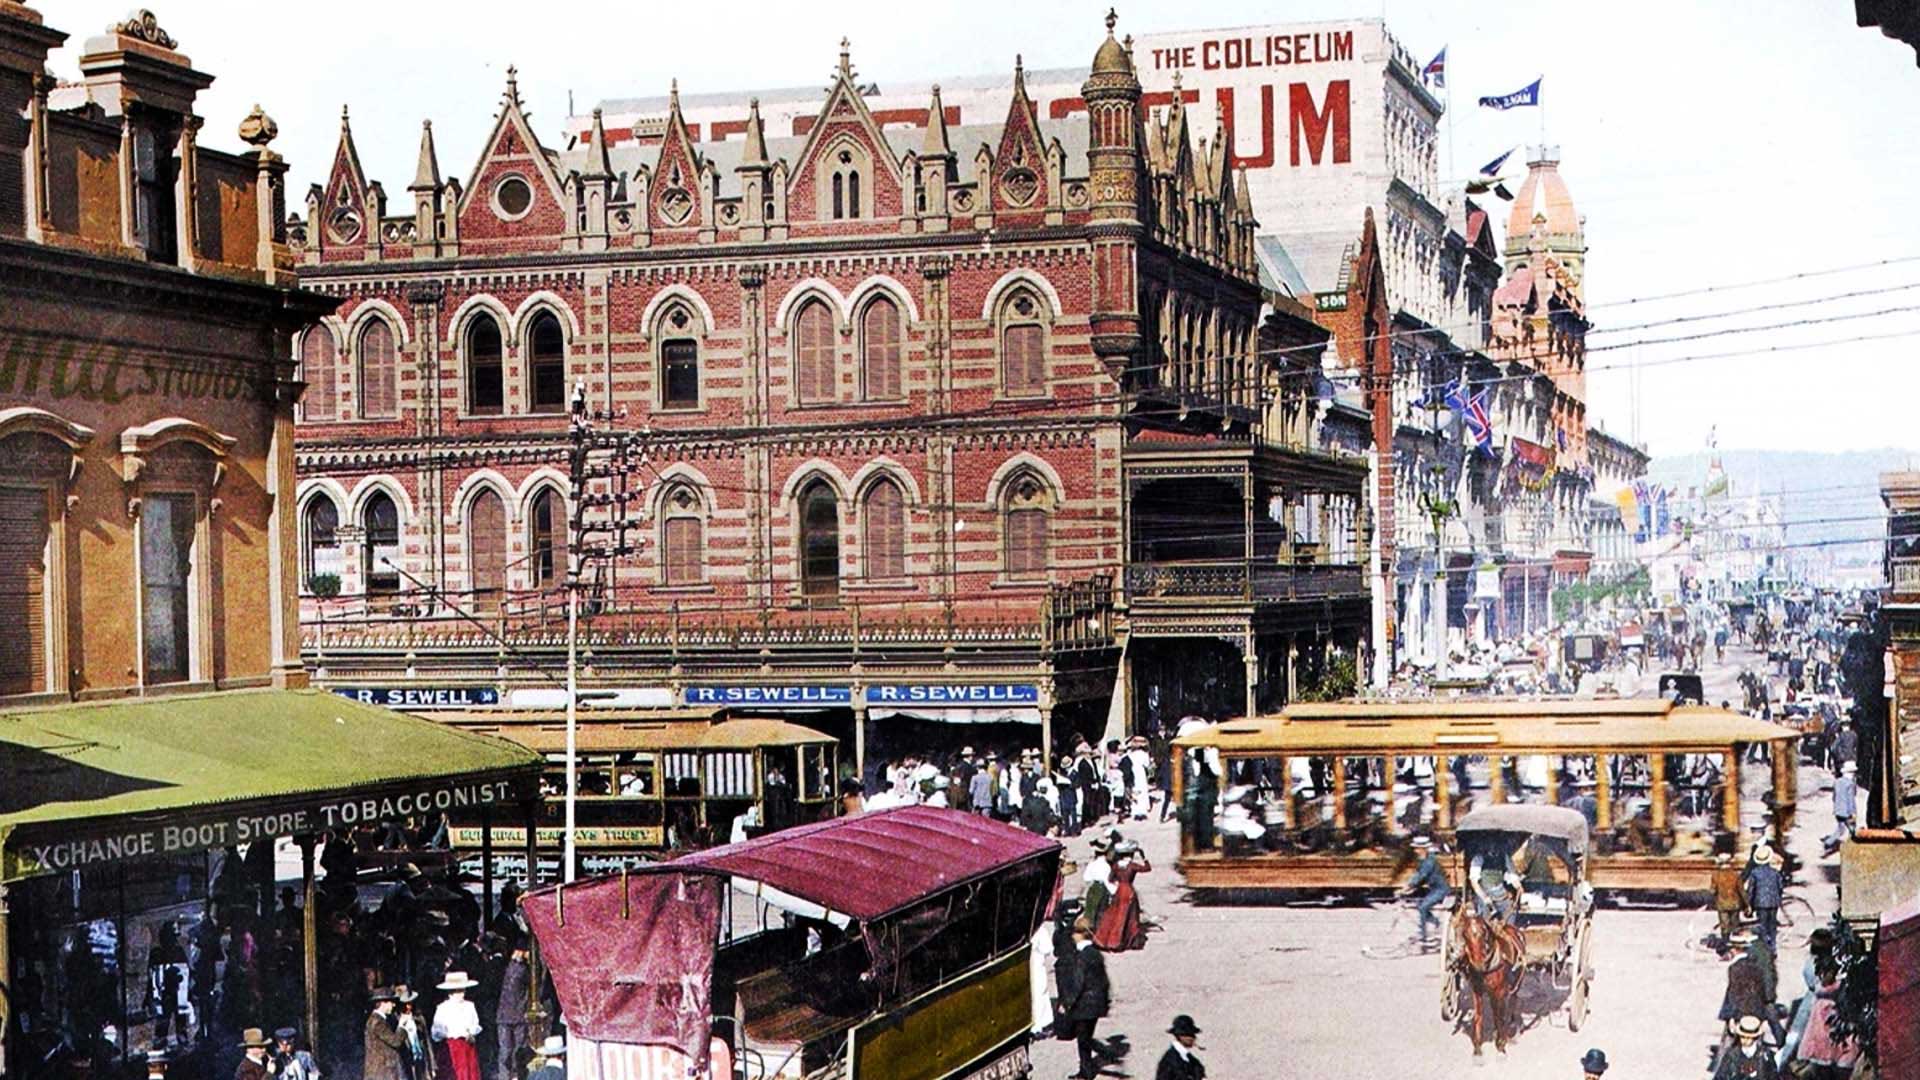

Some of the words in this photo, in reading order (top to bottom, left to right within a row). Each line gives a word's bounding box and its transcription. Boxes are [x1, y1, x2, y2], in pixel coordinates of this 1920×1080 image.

[1152, 47, 1195, 69] THE
[1203, 31, 1353, 70] COLISEUM
[388, 690, 473, 705] SEWELL
[163, 821, 229, 851] BOOT
[320, 782, 516, 826] TOBACCONIST.
